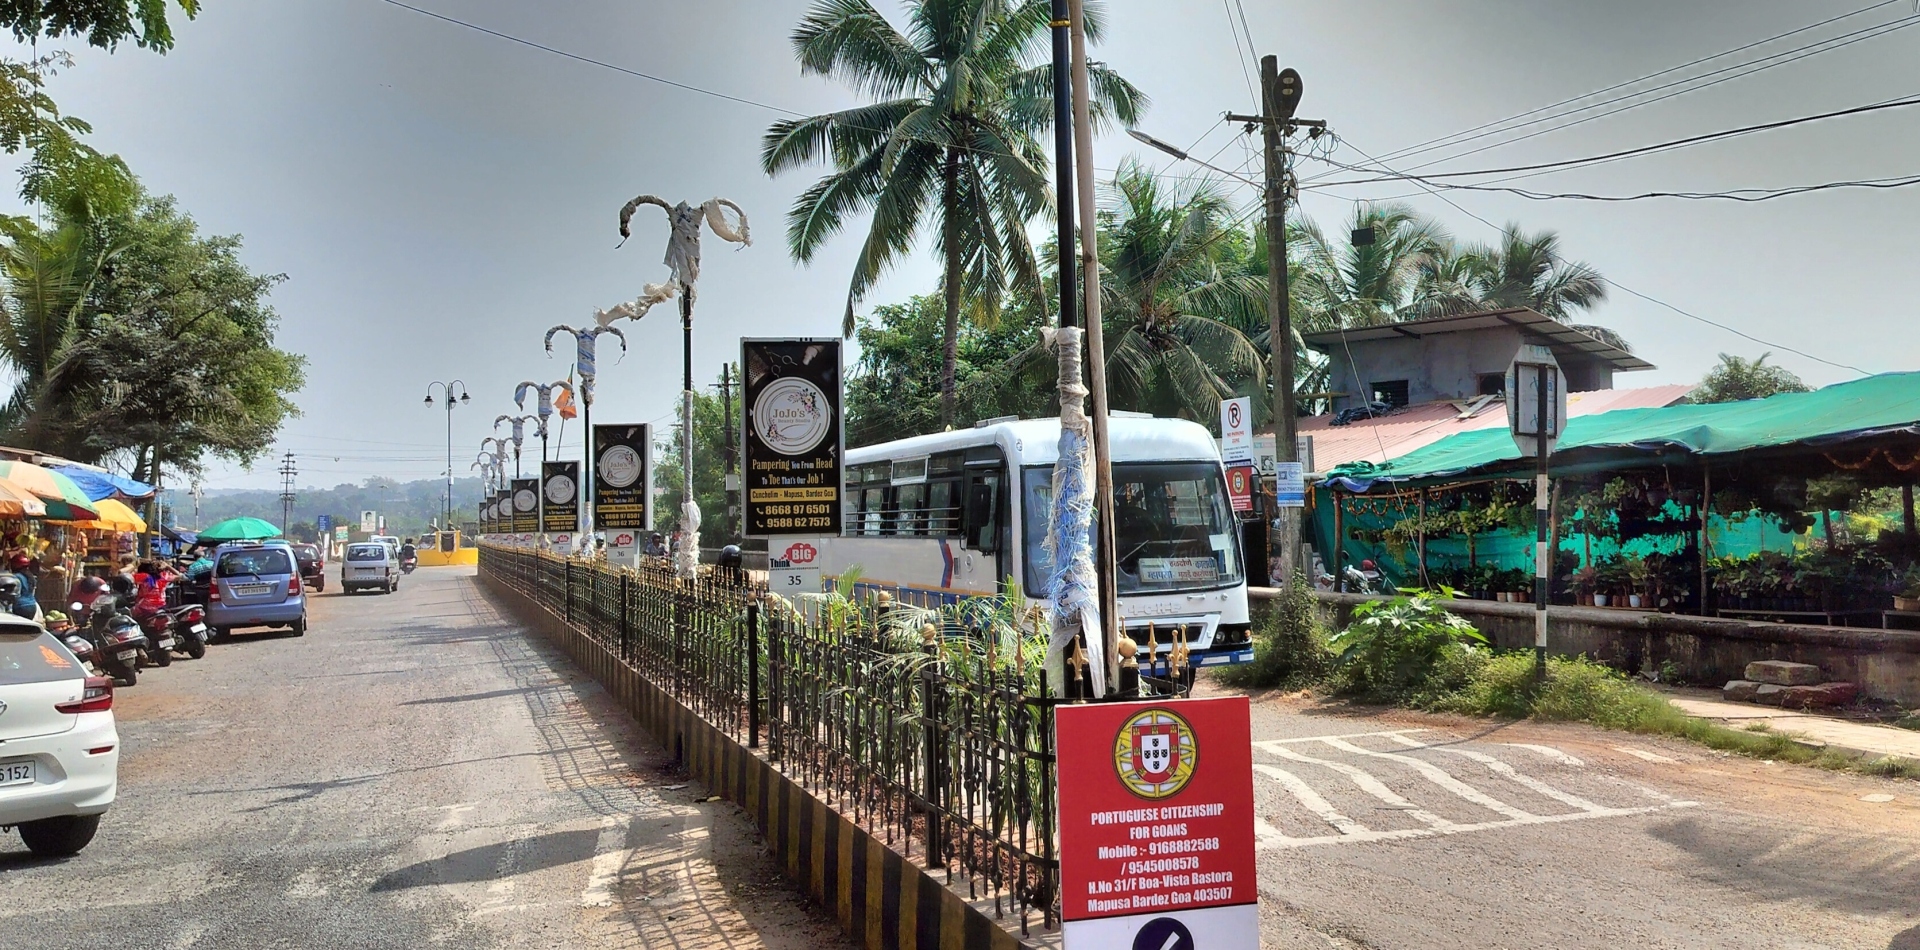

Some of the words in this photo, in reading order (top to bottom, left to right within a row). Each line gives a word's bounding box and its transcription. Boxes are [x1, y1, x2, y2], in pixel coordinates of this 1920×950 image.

[772, 408, 806, 418] JoJo's
[752, 458, 790, 471] Pampering
[816, 458, 833, 468] Head
[768, 474, 780, 484] Toe
[781, 476, 796, 484] That's
[806, 473, 819, 484] Job
[784, 490, 804, 499] Mapusa,
[765, 506, 791, 515] 8668
[793, 505, 804, 514] 97
[806, 504, 830, 514] 6501
[766, 518, 792, 528] 9588
[794, 518, 807, 527] 62
[808, 517, 831, 527] 7573
[770, 558, 790, 568] Think
[788, 576, 802, 586] 35
[0, 765, 29, 781] 6152
[1091, 807, 1159, 826] PORTUGUESE
[1160, 803, 1224, 820] CITIZENSHIP
[1130, 826, 1150, 840] FOR
[1151, 823, 1187, 838] GOANS
[1098, 845, 1137, 860] Mobile
[1149, 838, 1219, 856] 9168882588
[1121, 862, 1126, 875] /
[1128, 857, 1199, 874] 9545008578
[1088, 880, 1113, 895] H.No
[1114, 878, 1136, 892] 31/F
[1138, 874, 1190, 890] Boa-Vista
[1191, 870, 1233, 886] Bastora
[1087, 897, 1131, 913] Mapusa
[1132, 893, 1169, 908] Bardez
[1170, 890, 1192, 904] Goa
[1193, 886, 1232, 901] 403507
